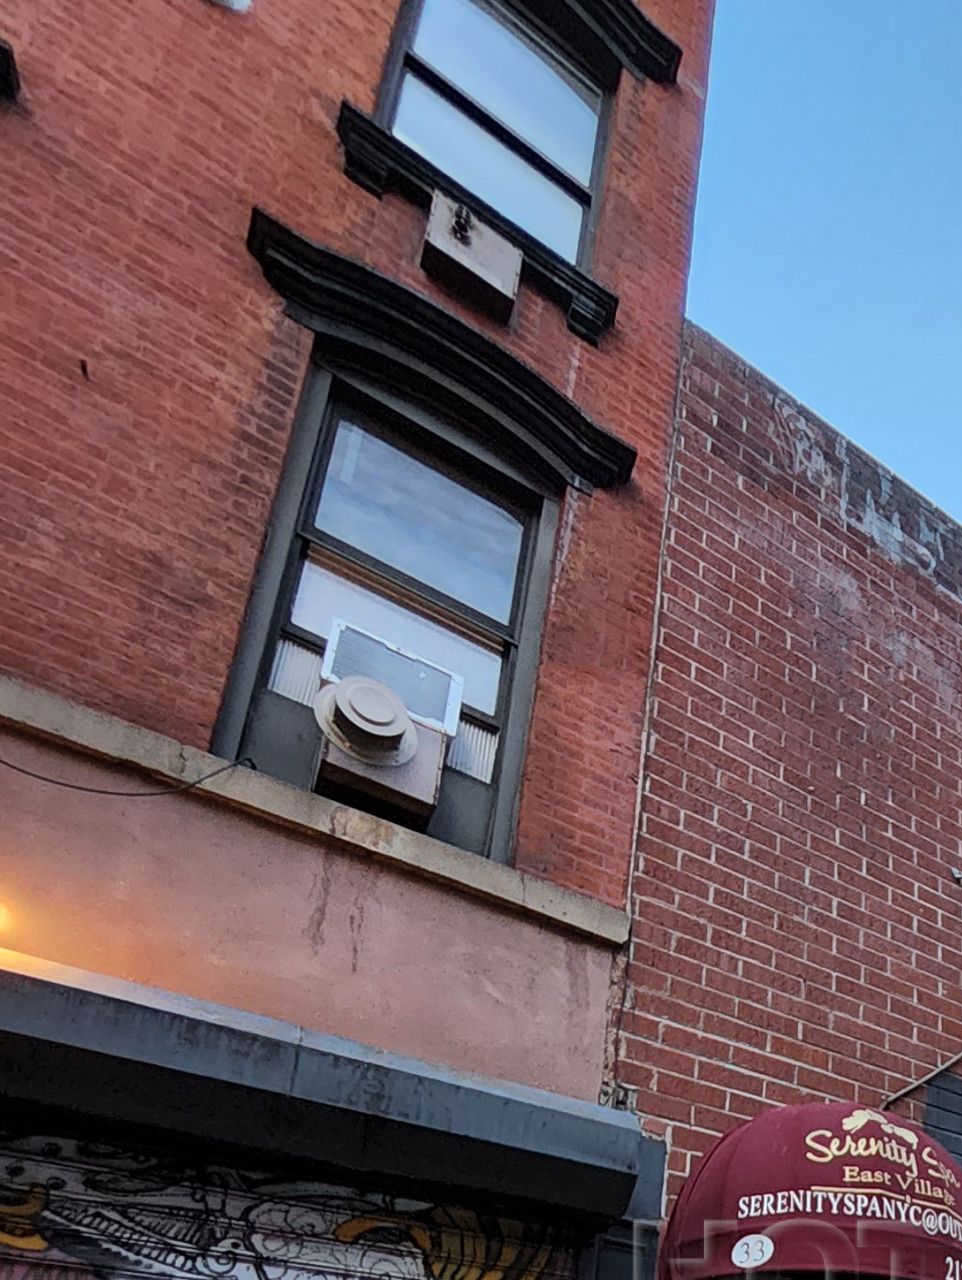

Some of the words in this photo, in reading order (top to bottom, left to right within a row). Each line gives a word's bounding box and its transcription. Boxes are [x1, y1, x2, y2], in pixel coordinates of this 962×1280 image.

[805, 1129, 919, 1178] Serenity
[842, 1166, 892, 1186] East
[741, 1239, 765, 1265] 33
